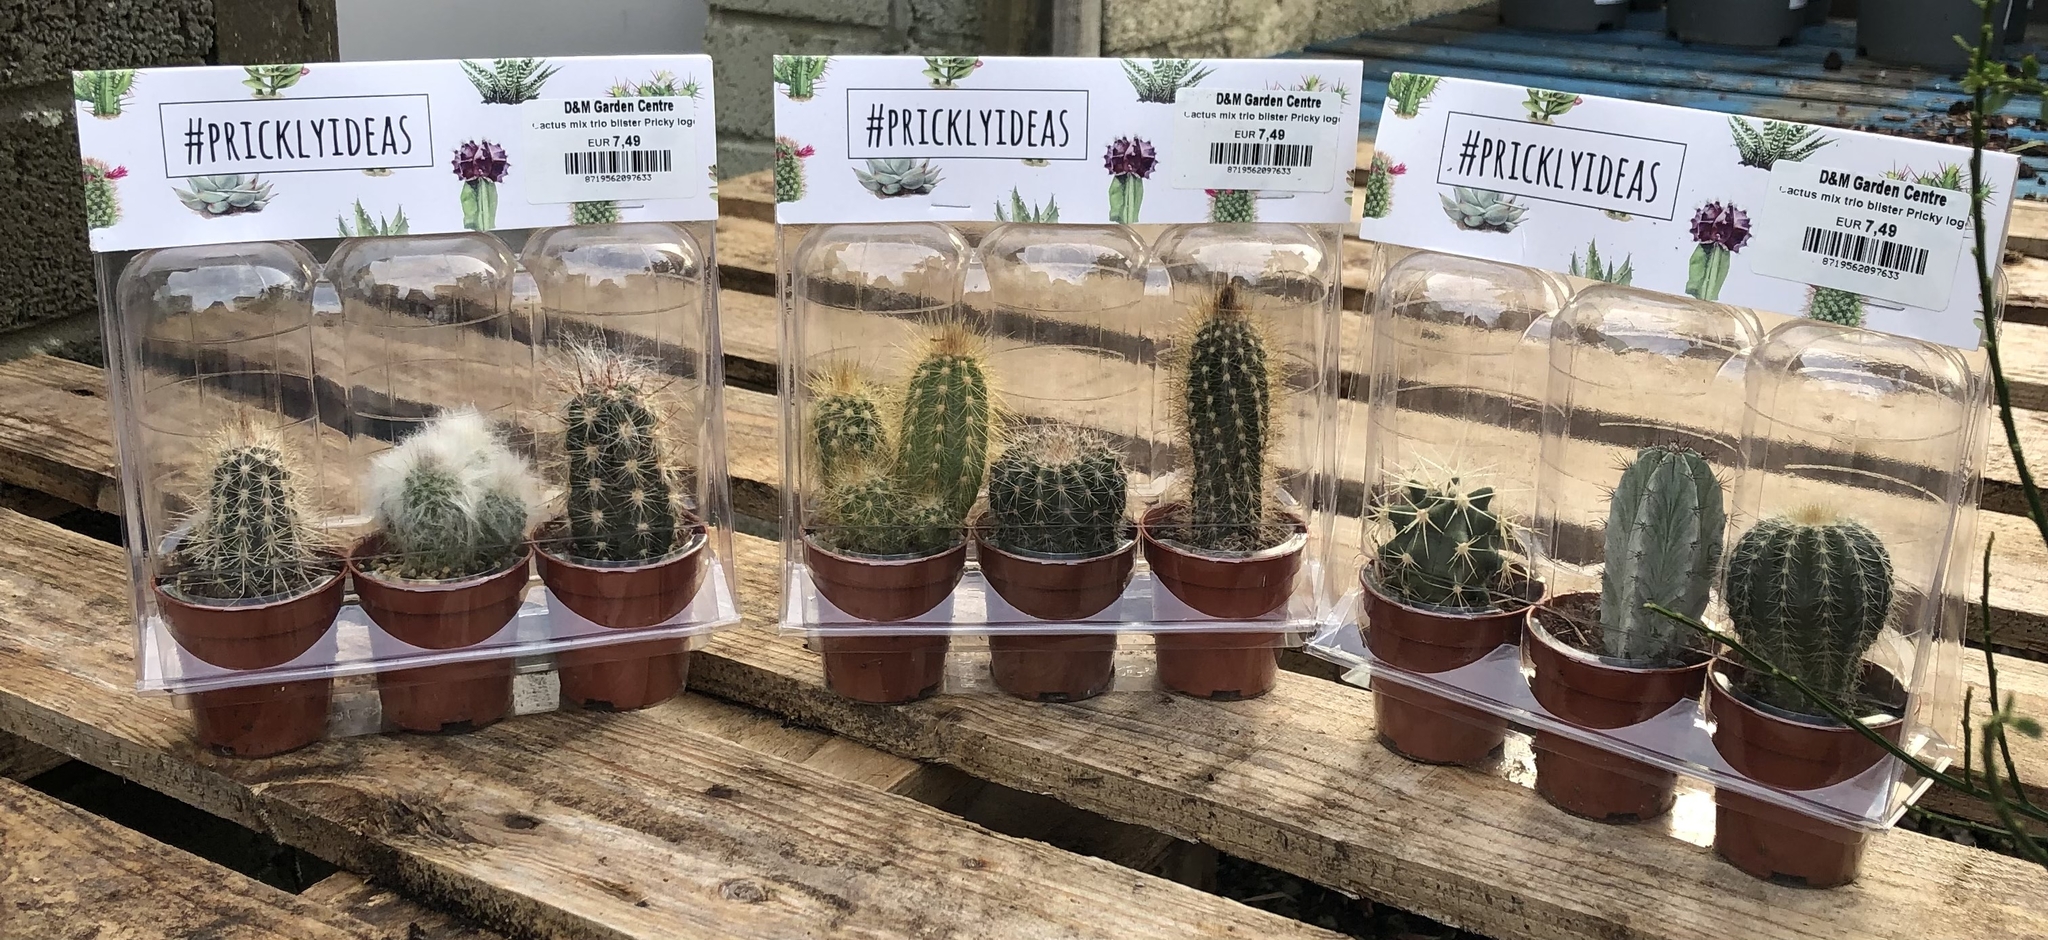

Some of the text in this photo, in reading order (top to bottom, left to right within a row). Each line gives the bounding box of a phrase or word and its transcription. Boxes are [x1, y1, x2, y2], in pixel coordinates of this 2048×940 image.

[564, 99, 674, 114] D&M Garden Centre
[1216, 93, 1322, 109] D&M Garden Centre
[570, 120, 588, 129] mix
[590, 119, 607, 128] trio
[611, 119, 641, 128] blister
[645, 118, 674, 128] Pricky
[866, 103, 1069, 148] #PRICKLYIDEAS
[1219, 111, 1236, 120] mix
[1239, 112, 1255, 121] trio
[1259, 112, 1287, 122] blister
[1291, 113, 1319, 124] Pricky
[184, 115, 412, 165] #PRICKLYIDEAS
[588, 135, 641, 149] EUR 7,49
[1235, 128, 1285, 142] EUR 7,49
[1227, 166, 1292, 175] 8719562097633
[1458, 129, 1661, 203] #PRICKLYIDEAS
[585, 173, 652, 183] 8719562097633
[1819, 169, 1947, 207] D&M Garden Centre
[1821, 193, 1841, 205] mix
[1844, 196, 1864, 208] trio
[1867, 200, 1903, 216] blister
[1906, 207, 1943, 226] Pricky
[1946, 215, 1968, 231] log
[1836, 216, 1898, 238] EUR 7,49
[1822, 257, 1900, 281] 8719562097633
